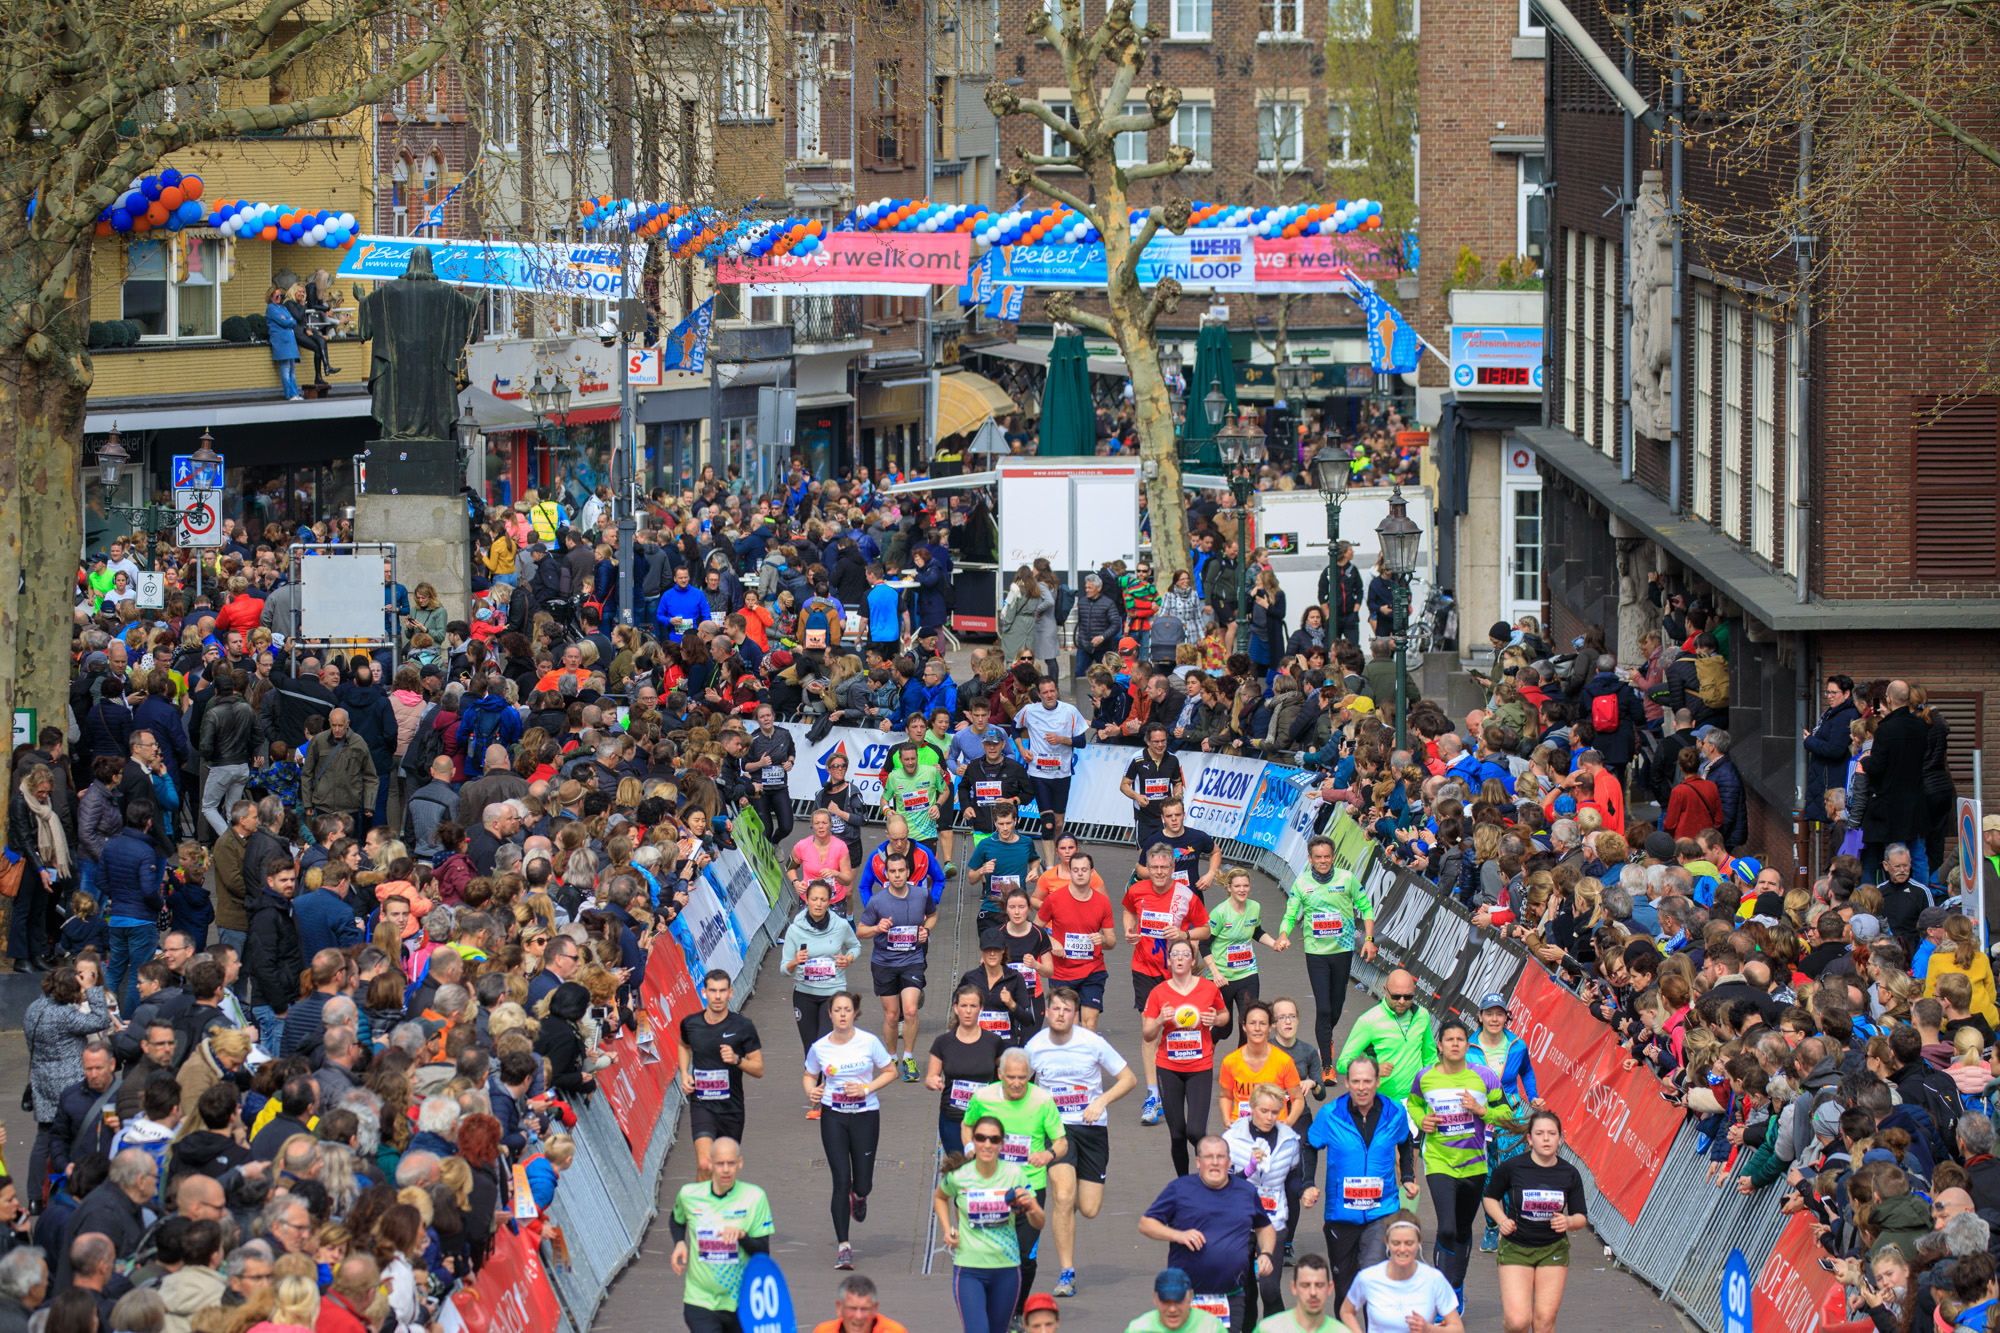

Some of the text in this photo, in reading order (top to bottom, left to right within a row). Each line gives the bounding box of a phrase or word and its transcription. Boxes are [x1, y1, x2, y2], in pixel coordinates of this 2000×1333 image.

[1151, 263, 1242, 280] VENLOOP
[1462, 330, 1482, 340] paul
[1469, 339, 1543, 349] schreinemacher
[1485, 367, 1529, 385] 13:03
[145, 585, 156, 593] 07
[1196, 767, 1254, 801] SEACON
[840, 1061, 866, 1070] ENEXIS
[1060, 1095, 1084, 1105] 83081
[1531, 1202, 1559, 1211] 34065
[750, 1274, 780, 1321] 60
[1728, 1270, 1747, 1318] 60
